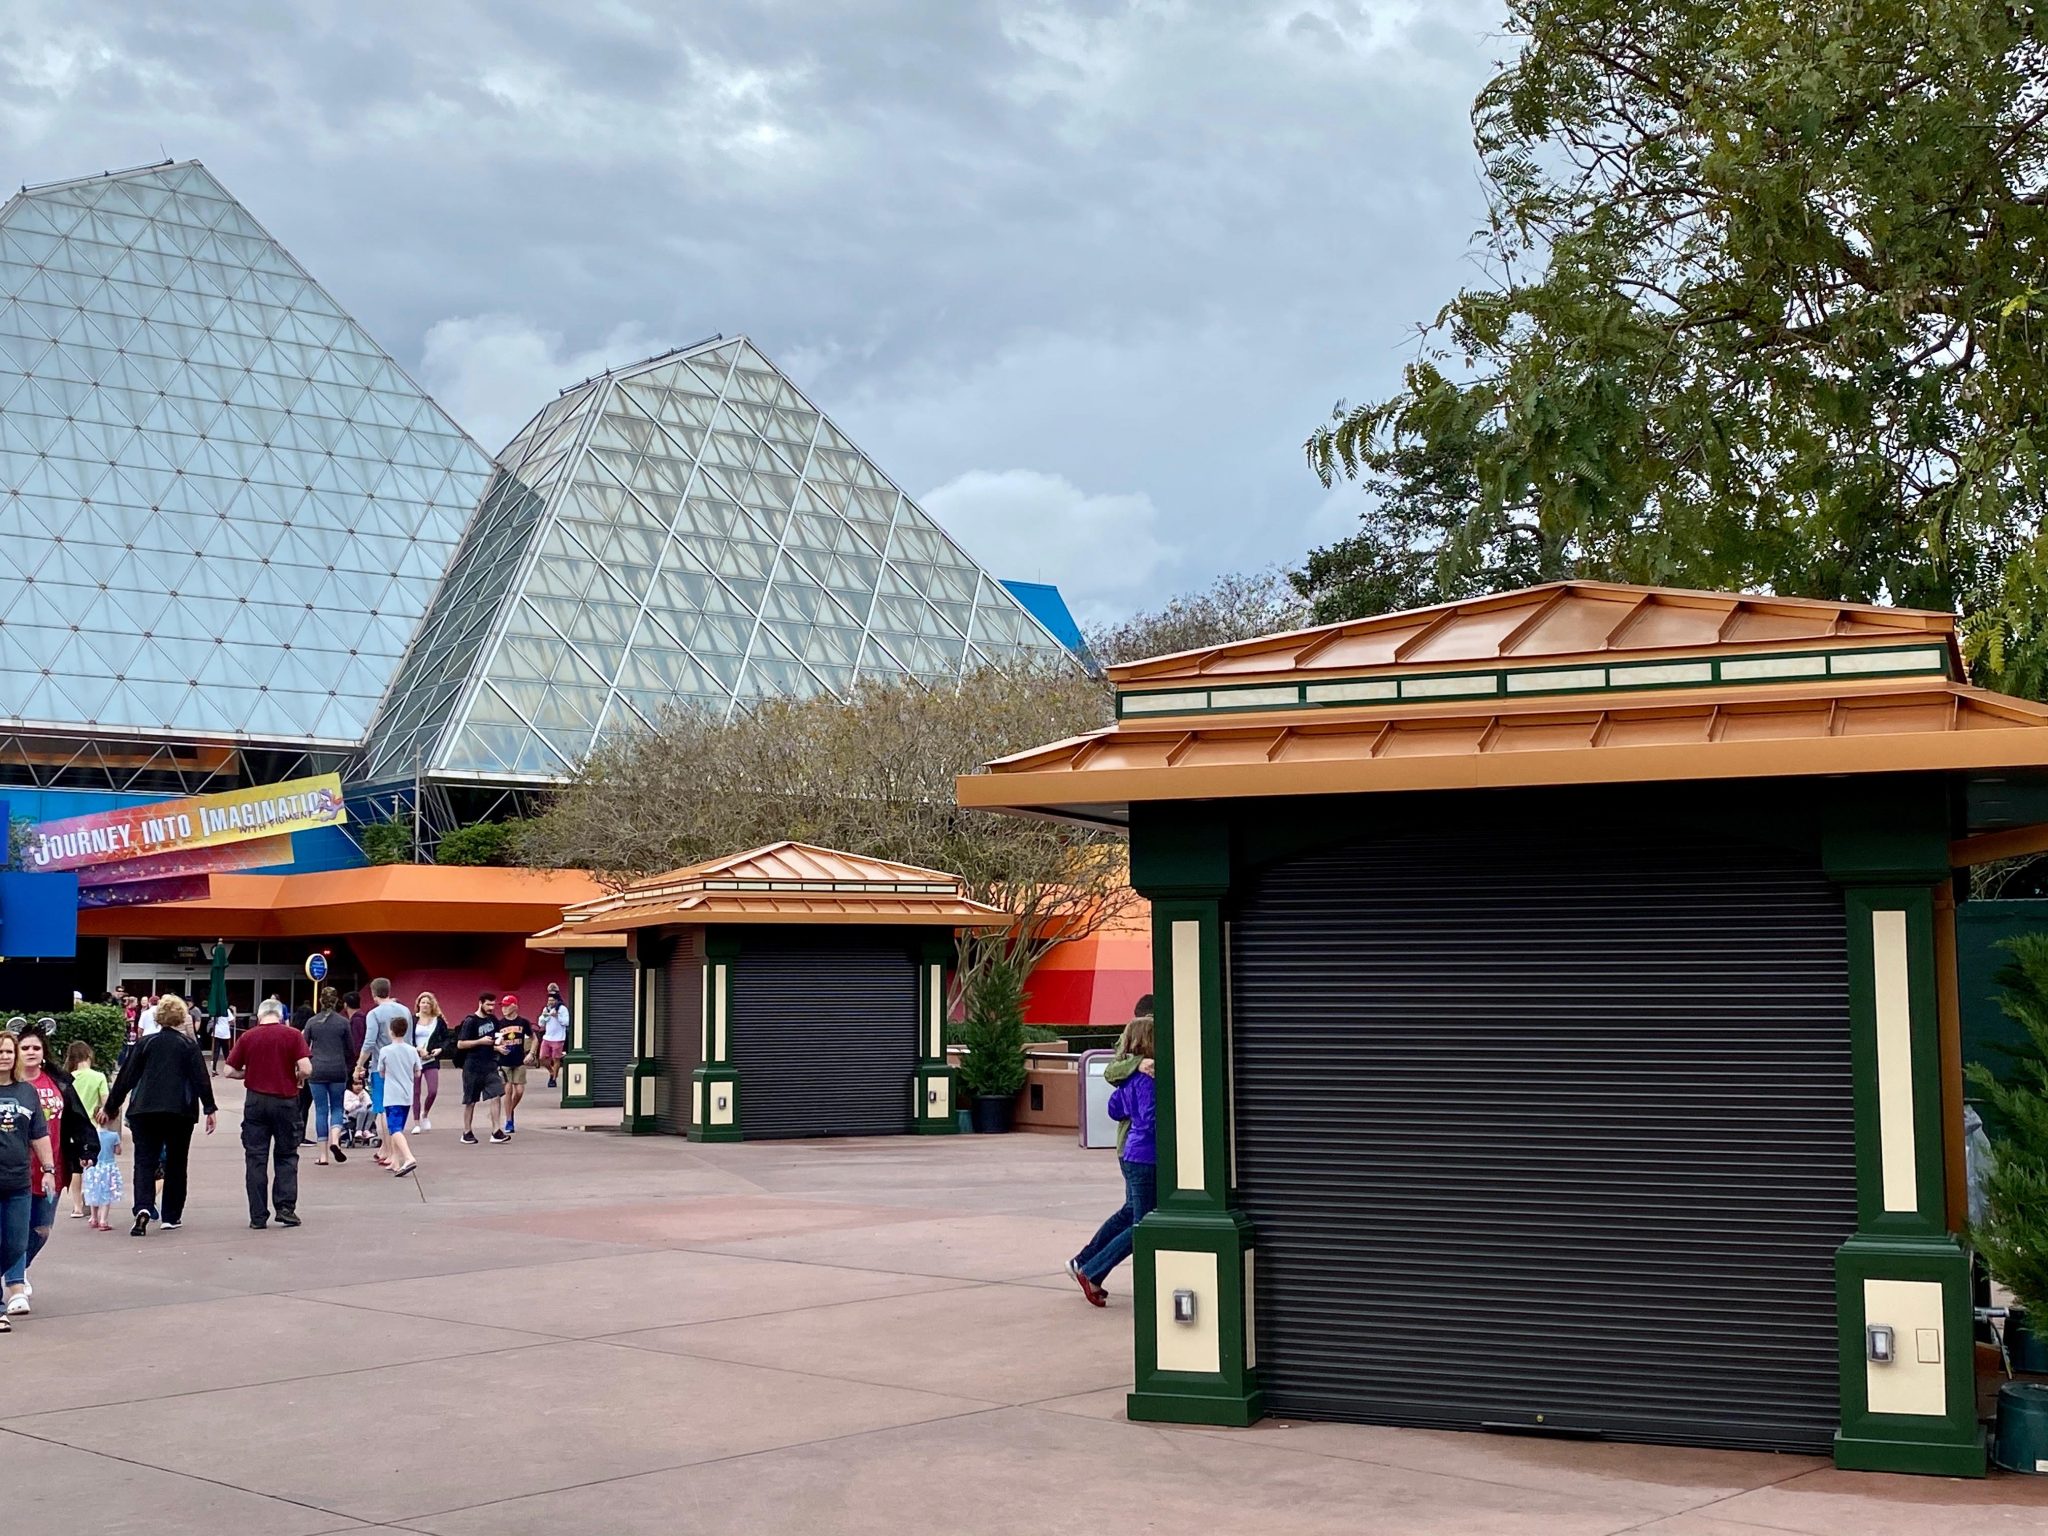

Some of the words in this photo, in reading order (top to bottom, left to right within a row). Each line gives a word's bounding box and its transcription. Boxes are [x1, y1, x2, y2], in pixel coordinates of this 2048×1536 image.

[33, 823, 131, 866] JOURNEY
[141, 814, 192, 845] INTO
[238, 822, 267, 835] WITH
[268, 809, 313, 829] FIGMENT
